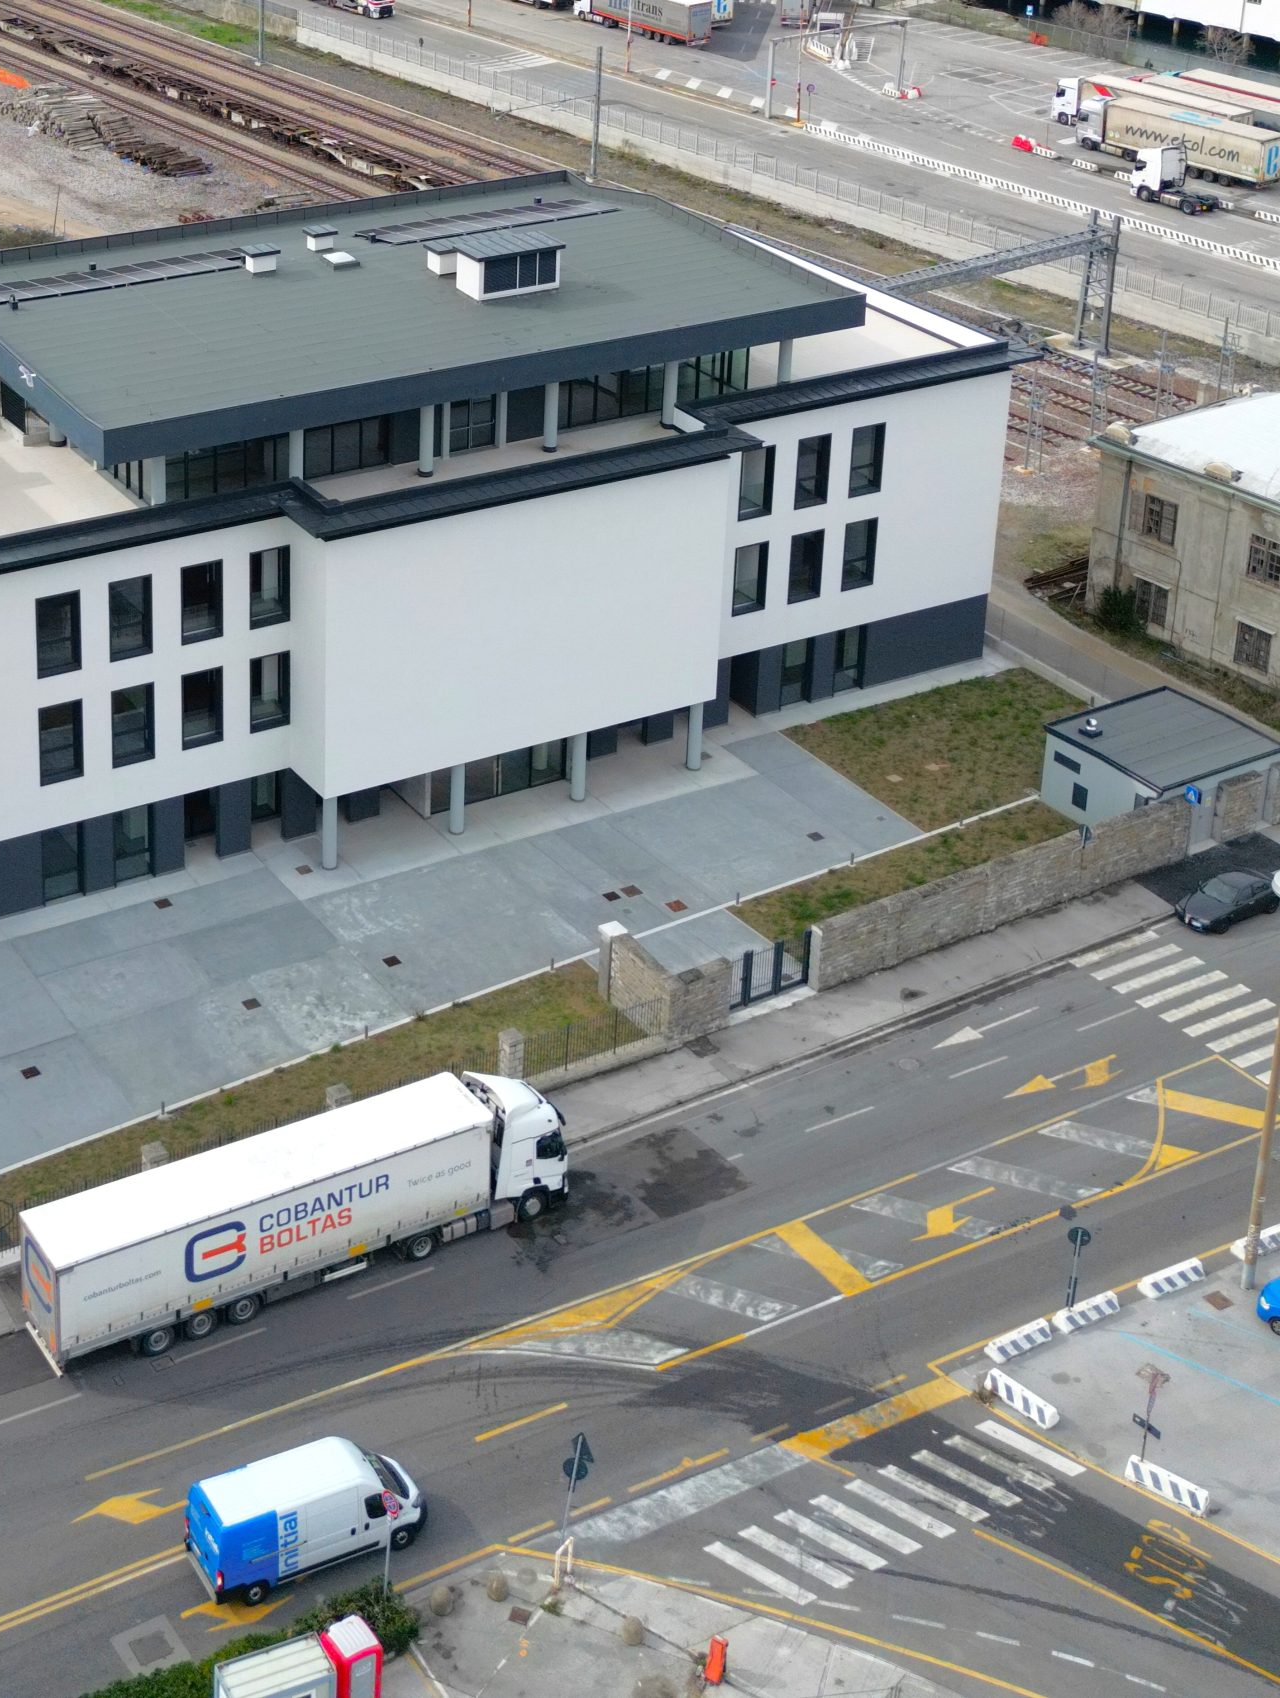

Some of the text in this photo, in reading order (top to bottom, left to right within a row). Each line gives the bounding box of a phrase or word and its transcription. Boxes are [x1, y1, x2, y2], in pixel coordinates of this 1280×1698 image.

[1125, 124, 1240, 163] www.ekol.com
[407, 1160, 471, 1188] Twice as good
[259, 1174, 390, 1233] COBANTUR
[259, 1207, 352, 1255] BOLTAS
[83, 1269, 162, 1302] cobanturboltas.com
[1123, 1519, 1212, 1599] STOP
